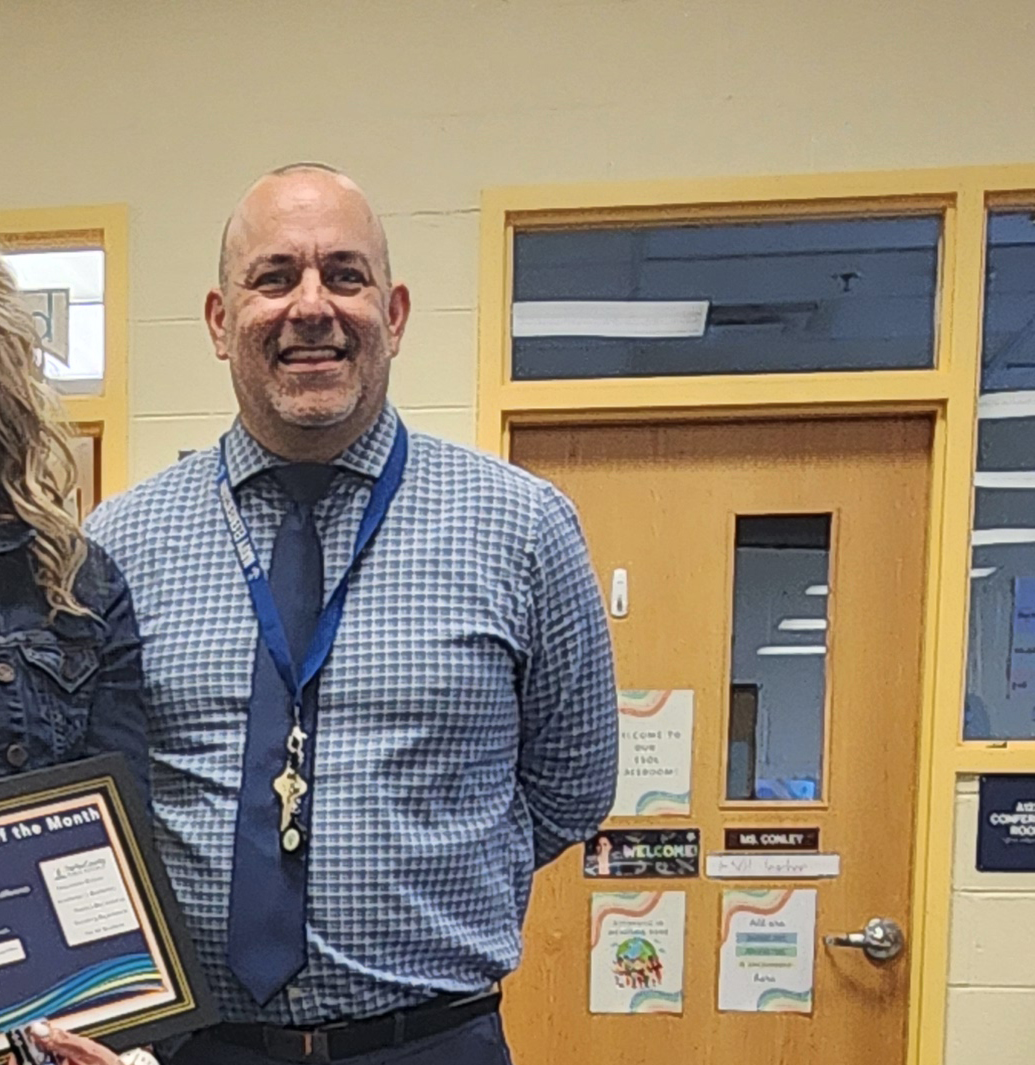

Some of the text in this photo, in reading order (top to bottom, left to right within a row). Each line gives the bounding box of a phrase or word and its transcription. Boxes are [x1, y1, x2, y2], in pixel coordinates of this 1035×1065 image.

[11, 822, 42, 840] the
[45, 807, 101, 832] Month
[760, 833, 804, 845] CONLEY
